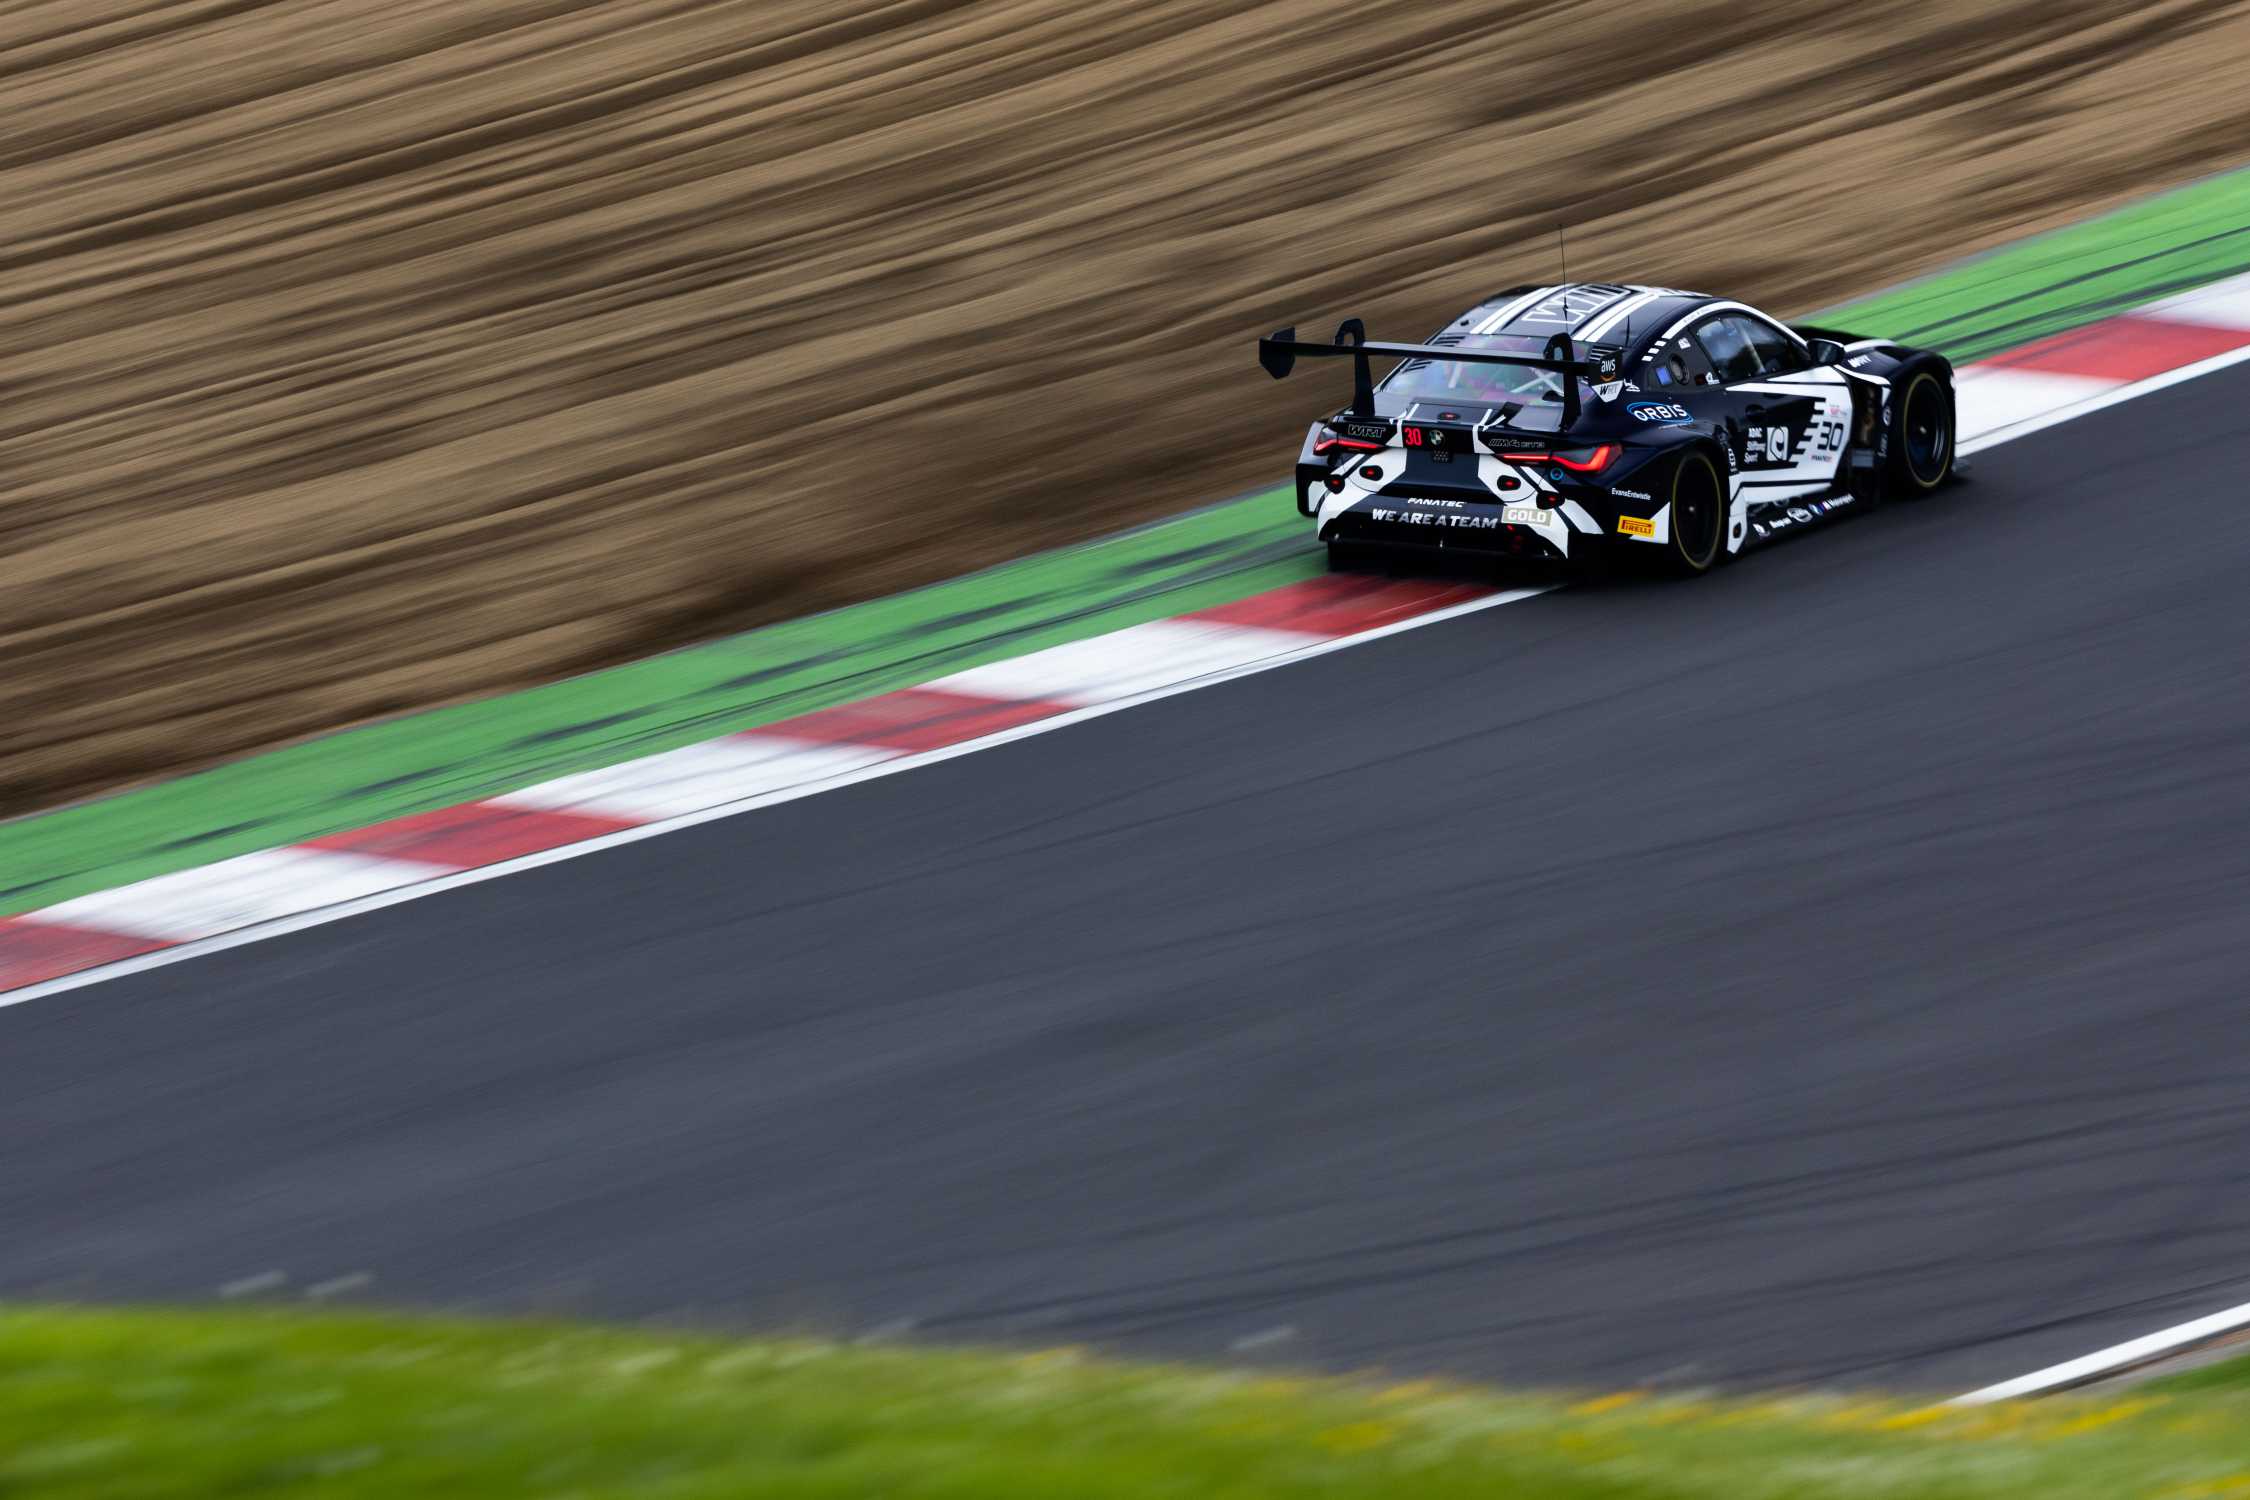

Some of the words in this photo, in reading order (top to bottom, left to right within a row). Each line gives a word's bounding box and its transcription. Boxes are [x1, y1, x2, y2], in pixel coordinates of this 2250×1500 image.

[1601, 358, 1616, 373] aws
[1634, 404, 1688, 422] ORBIS
[1348, 423, 1387, 438] WRT
[1404, 427, 1423, 446] 30
[1817, 421, 1844, 451] 30
[1407, 497, 1465, 508] FANATEC
[1372, 508, 1397, 522] WE
[1398, 511, 1434, 525] ARE
[1434, 514, 1447, 527] A
[1450, 515, 1499, 529] TEAM
[1507, 508, 1547, 523] GOLD
[1621, 519, 1653, 534] PIRELLI
